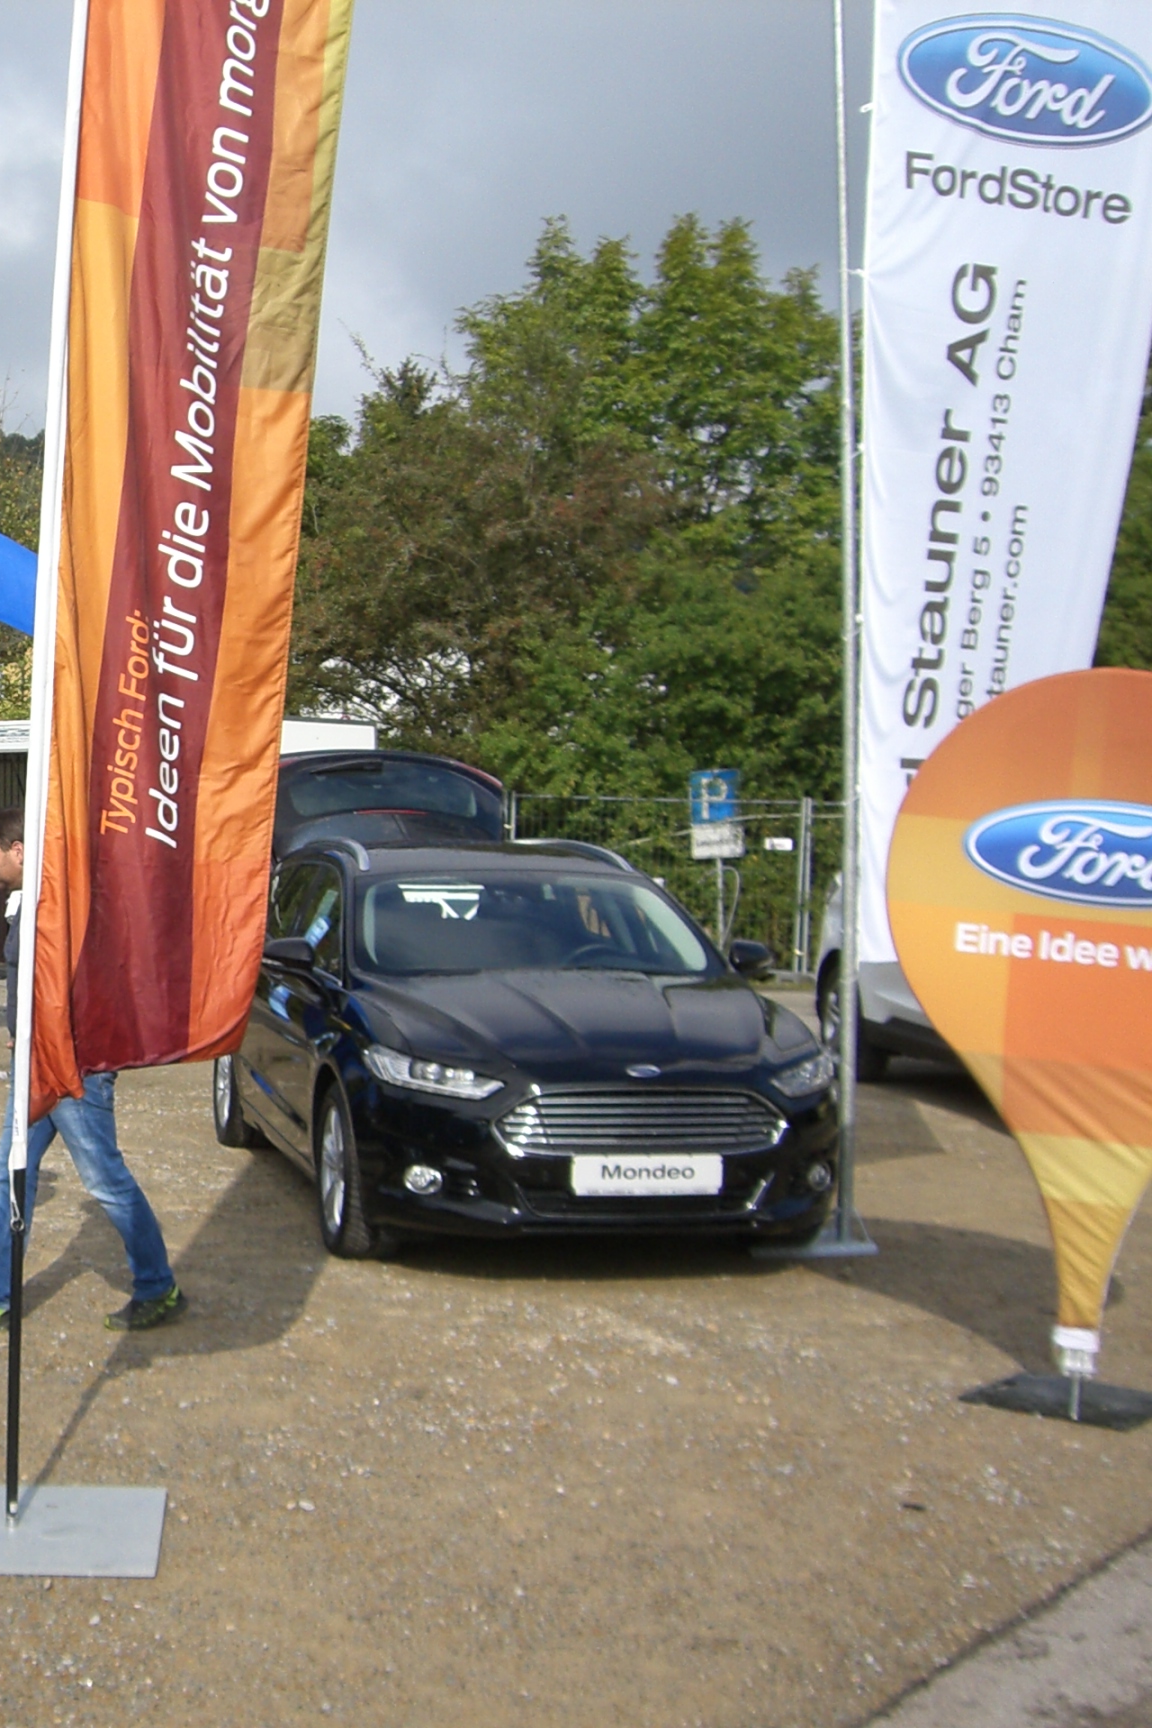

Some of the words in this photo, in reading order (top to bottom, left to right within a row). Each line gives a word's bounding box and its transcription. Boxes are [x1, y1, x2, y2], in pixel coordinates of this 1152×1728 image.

[946, 32, 1115, 129] Ford
[202, 127, 249, 224] von
[906, 151, 1133, 224] FordStore
[169, 237, 233, 492] Mobilität
[995, 279, 1028, 381] Cham
[980, 393, 1011, 497] 93413
[903, 408, 971, 729] Stauner
[947, 263, 998, 387] AG
[158, 502, 209, 589] die
[973, 536, 990, 562] 5
[152, 596, 198, 681] für
[960, 572, 991, 653] Berg
[100, 707, 143, 836] Typisch
[146, 697, 185, 849] Ideen
[701, 777, 728, 820] P
[955, 921, 1033, 959] Eine
[1039, 930, 1119, 968] Idee
[601, 1164, 696, 1180] Mondeo
